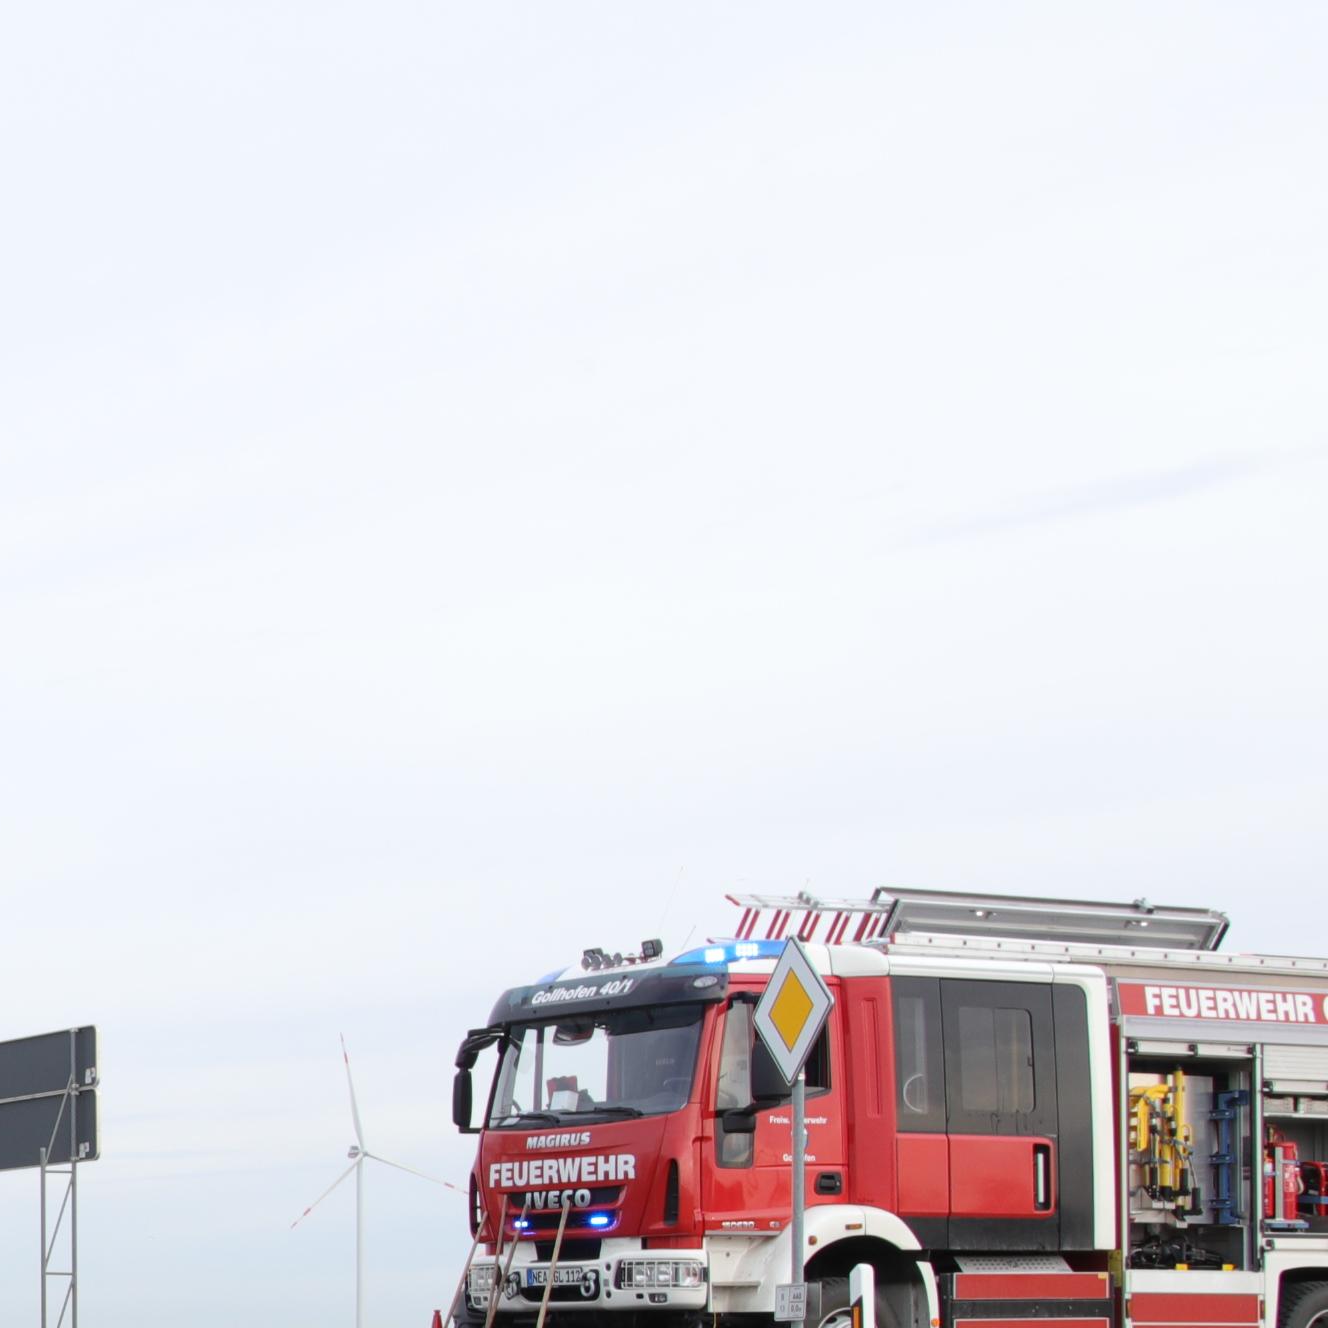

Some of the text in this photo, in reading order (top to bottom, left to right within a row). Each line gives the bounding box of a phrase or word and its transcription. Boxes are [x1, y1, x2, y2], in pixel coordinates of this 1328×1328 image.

[531, 978, 634, 1004] Gollhofen 40/1
[1144, 985, 1316, 1023] FEUERWEHR
[526, 1132, 591, 1149] MAGIRUS
[489, 1154, 636, 1188] FEUERWEHR
[526, 1188, 591, 1209] IVECO
[532, 1271, 548, 1284] NEA
[566, 1269, 581, 1283] 112
